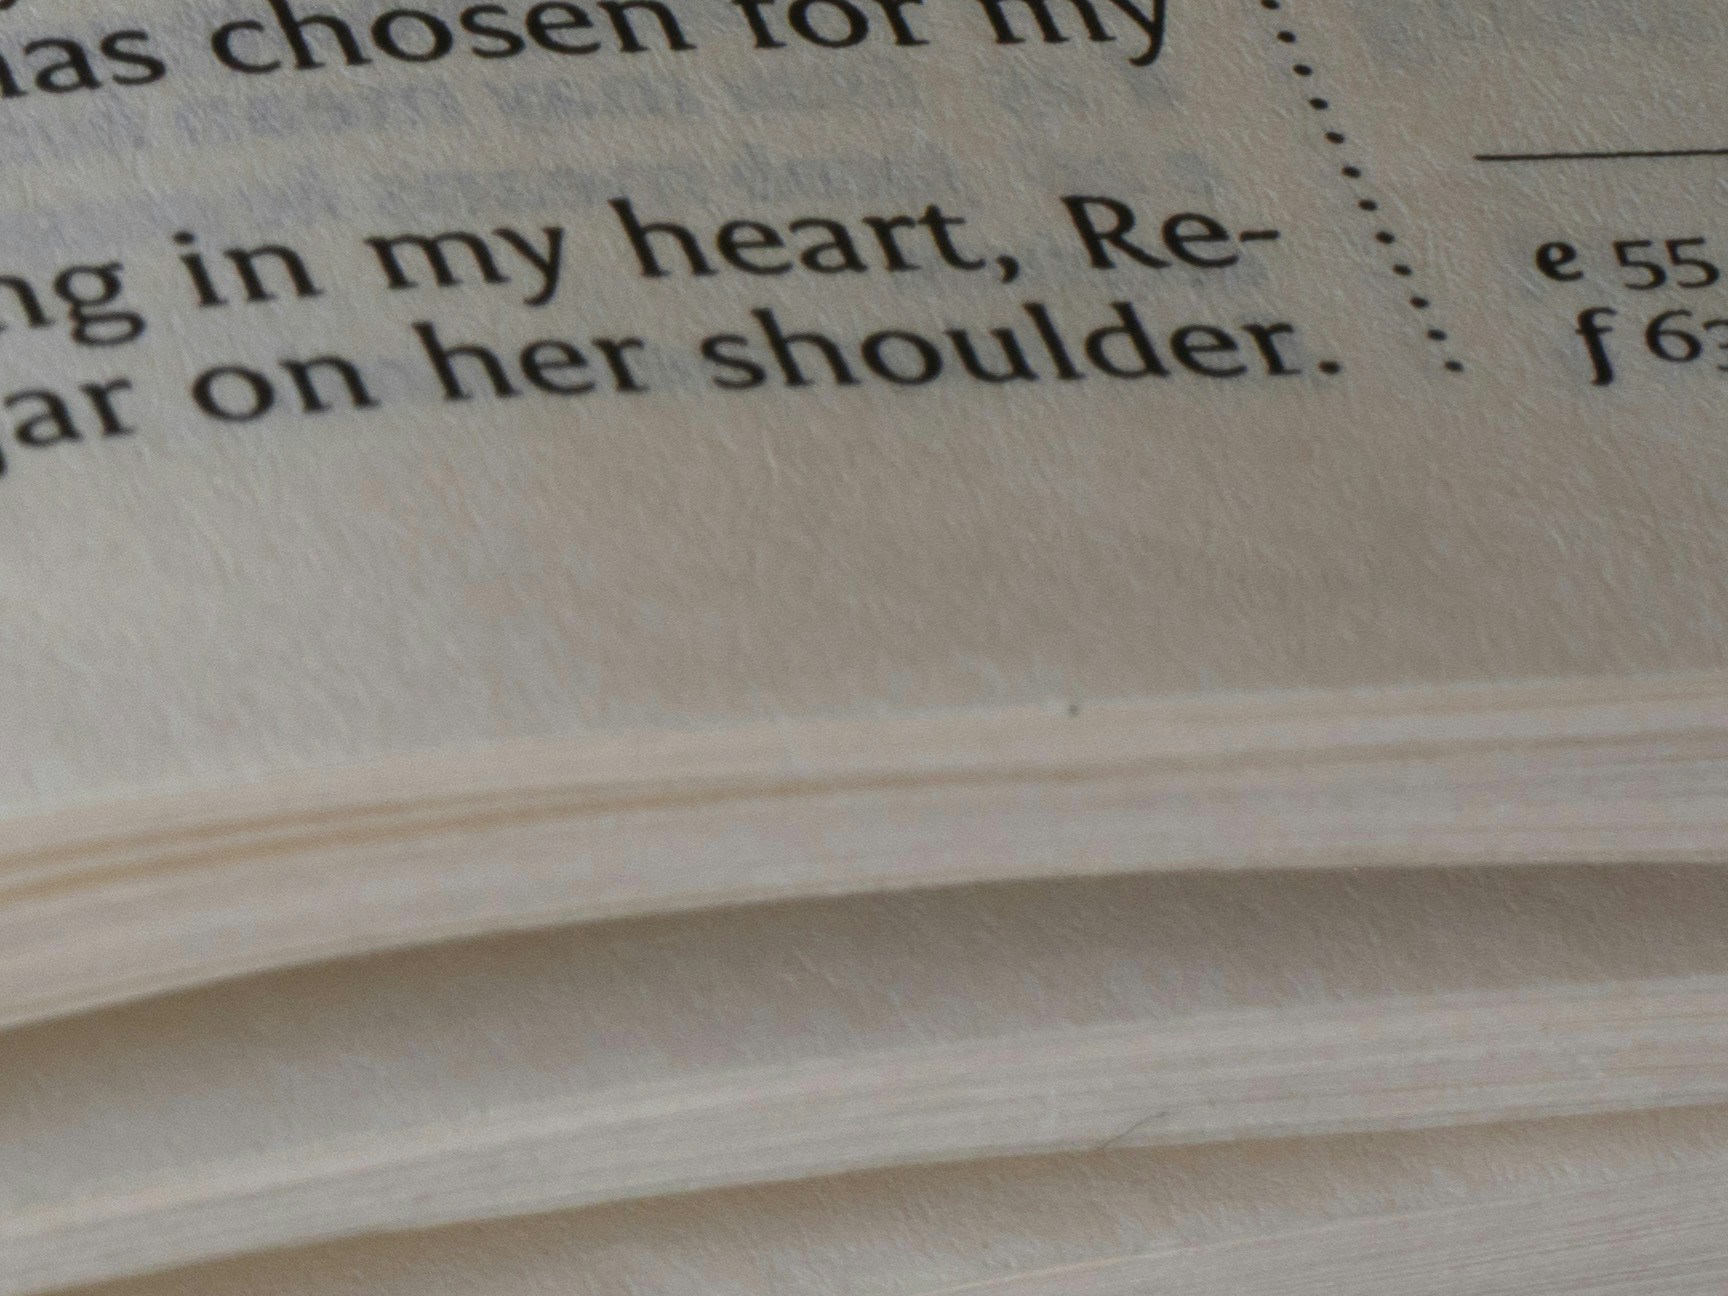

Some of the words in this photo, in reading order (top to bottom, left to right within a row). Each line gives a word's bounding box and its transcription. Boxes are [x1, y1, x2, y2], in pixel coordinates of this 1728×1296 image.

[170, 228, 325, 310] in
[362, 224, 567, 310] my
[605, 194, 1023, 287] heart,
[1057, 192, 1283, 273] Re-
[1610, 234, 1723, 294] 55
[189, 353, 381, 425] on
[409, 318, 650, 404] her
[697, 298, 1344, 393] shoulder.
